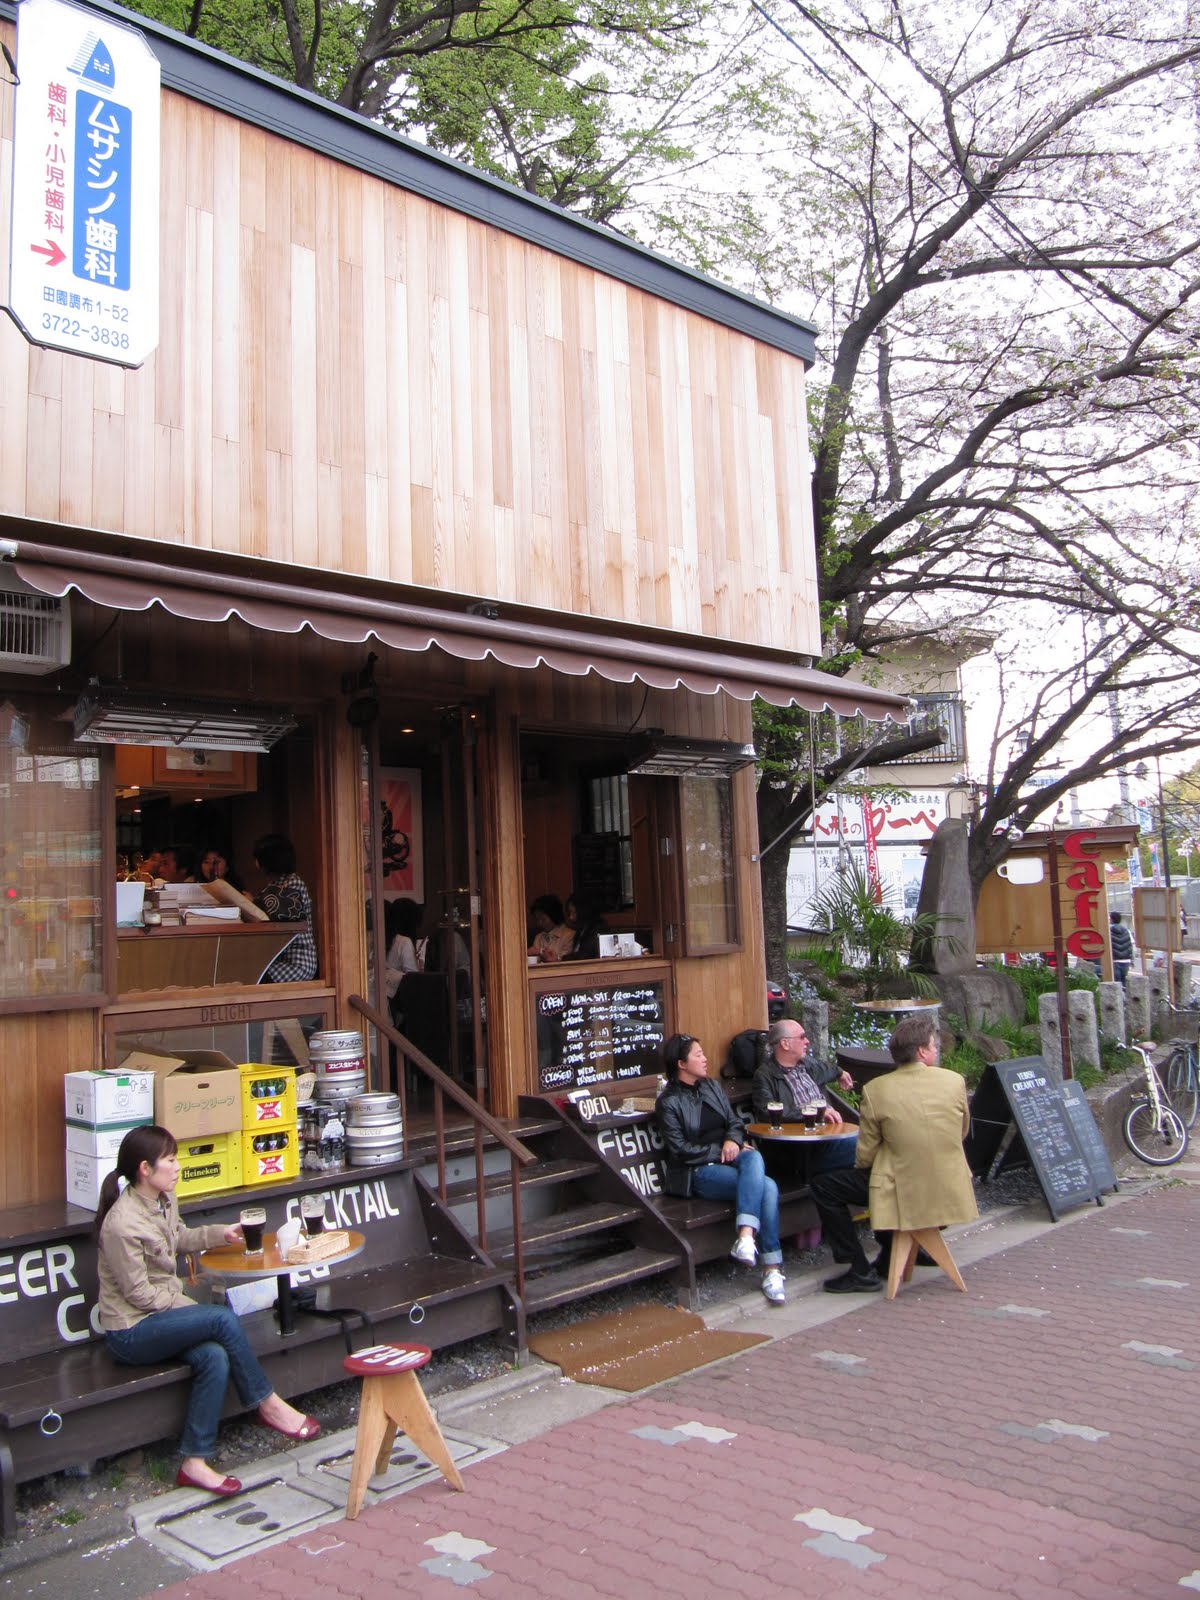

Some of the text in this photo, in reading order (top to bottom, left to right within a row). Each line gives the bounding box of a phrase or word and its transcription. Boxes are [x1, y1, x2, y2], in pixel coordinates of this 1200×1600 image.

[44, 81, 68, 235] 歯科・小児歯科
[84, 99, 121, 286] ムサシノ歯科
[42, 285, 130, 323] 田園調布1-52
[41, 312, 130, 350] 3722-3838
[201, 1005, 253, 1022] DELIGHT
[542, 997, 564, 1011] OPEN
[545, 1070, 572, 1084] CLOSED
[579, 1096, 611, 1121] OPEN
[184, 1166, 219, 1178] Heineken
[286, 1180, 400, 1230] CCKTAIL
